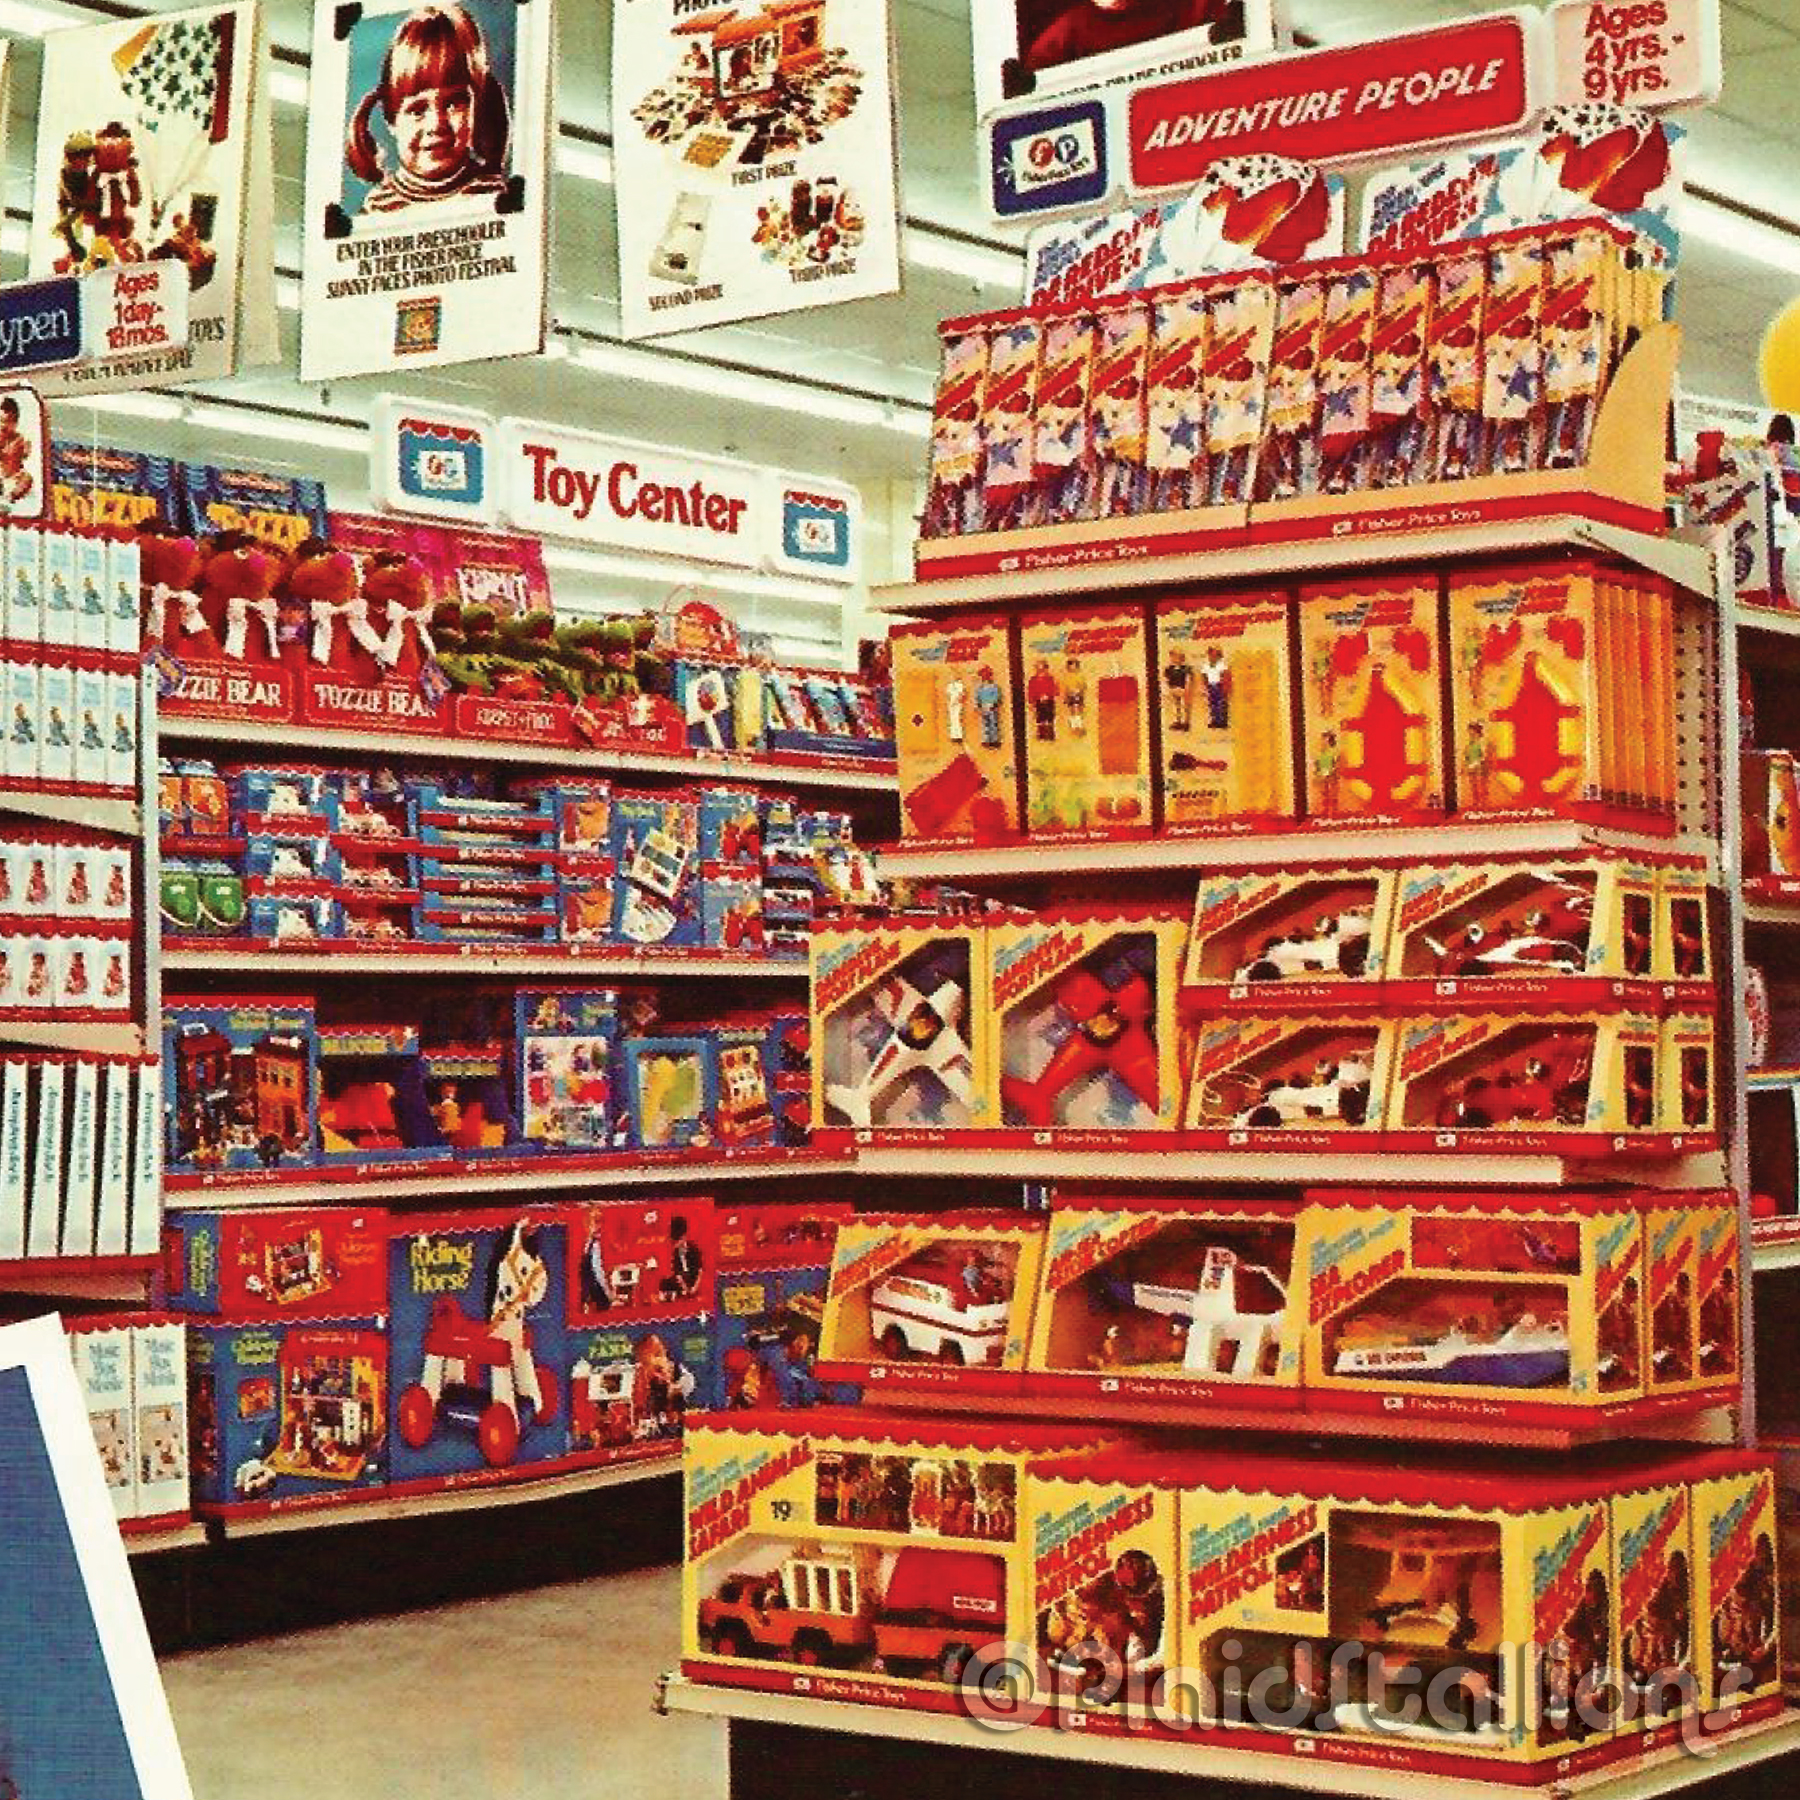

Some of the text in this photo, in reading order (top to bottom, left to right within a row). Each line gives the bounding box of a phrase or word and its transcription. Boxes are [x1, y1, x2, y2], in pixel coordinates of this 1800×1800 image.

[1584, 0, 1667, 39] Ages
[1585, 36, 1607, 68] 4
[1582, 66, 1669, 107] 9 yrs.
[1144, 58, 1505, 152] ADVENTURE PEOPLE
[114, 272, 159, 299] Ages
[522, 443, 748, 534] Toy Center
[226, 679, 282, 708] BEAR
[410, 1235, 473, 1271] Riding
[411, 1266, 469, 1294] Horse
[771, 1500, 791, 1522] 19
